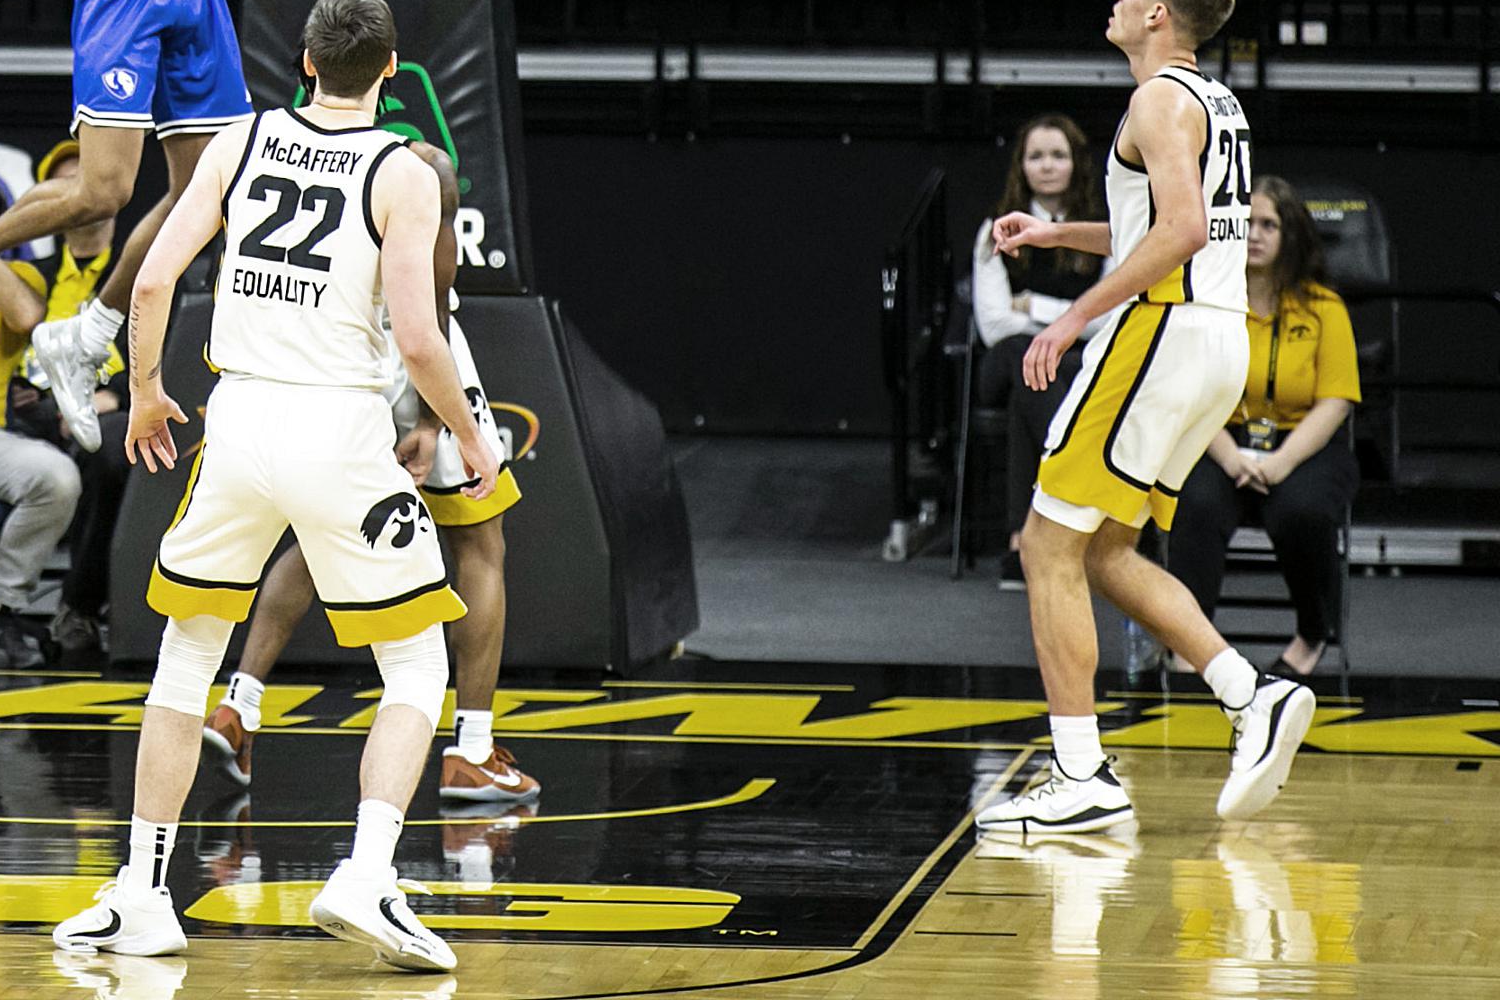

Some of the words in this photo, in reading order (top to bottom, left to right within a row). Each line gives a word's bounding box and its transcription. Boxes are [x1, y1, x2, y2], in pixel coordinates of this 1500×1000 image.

[261, 136, 363, 175] McCAFFERY
[238, 174, 347, 273] 22
[232, 268, 327, 308] EQUALITY
